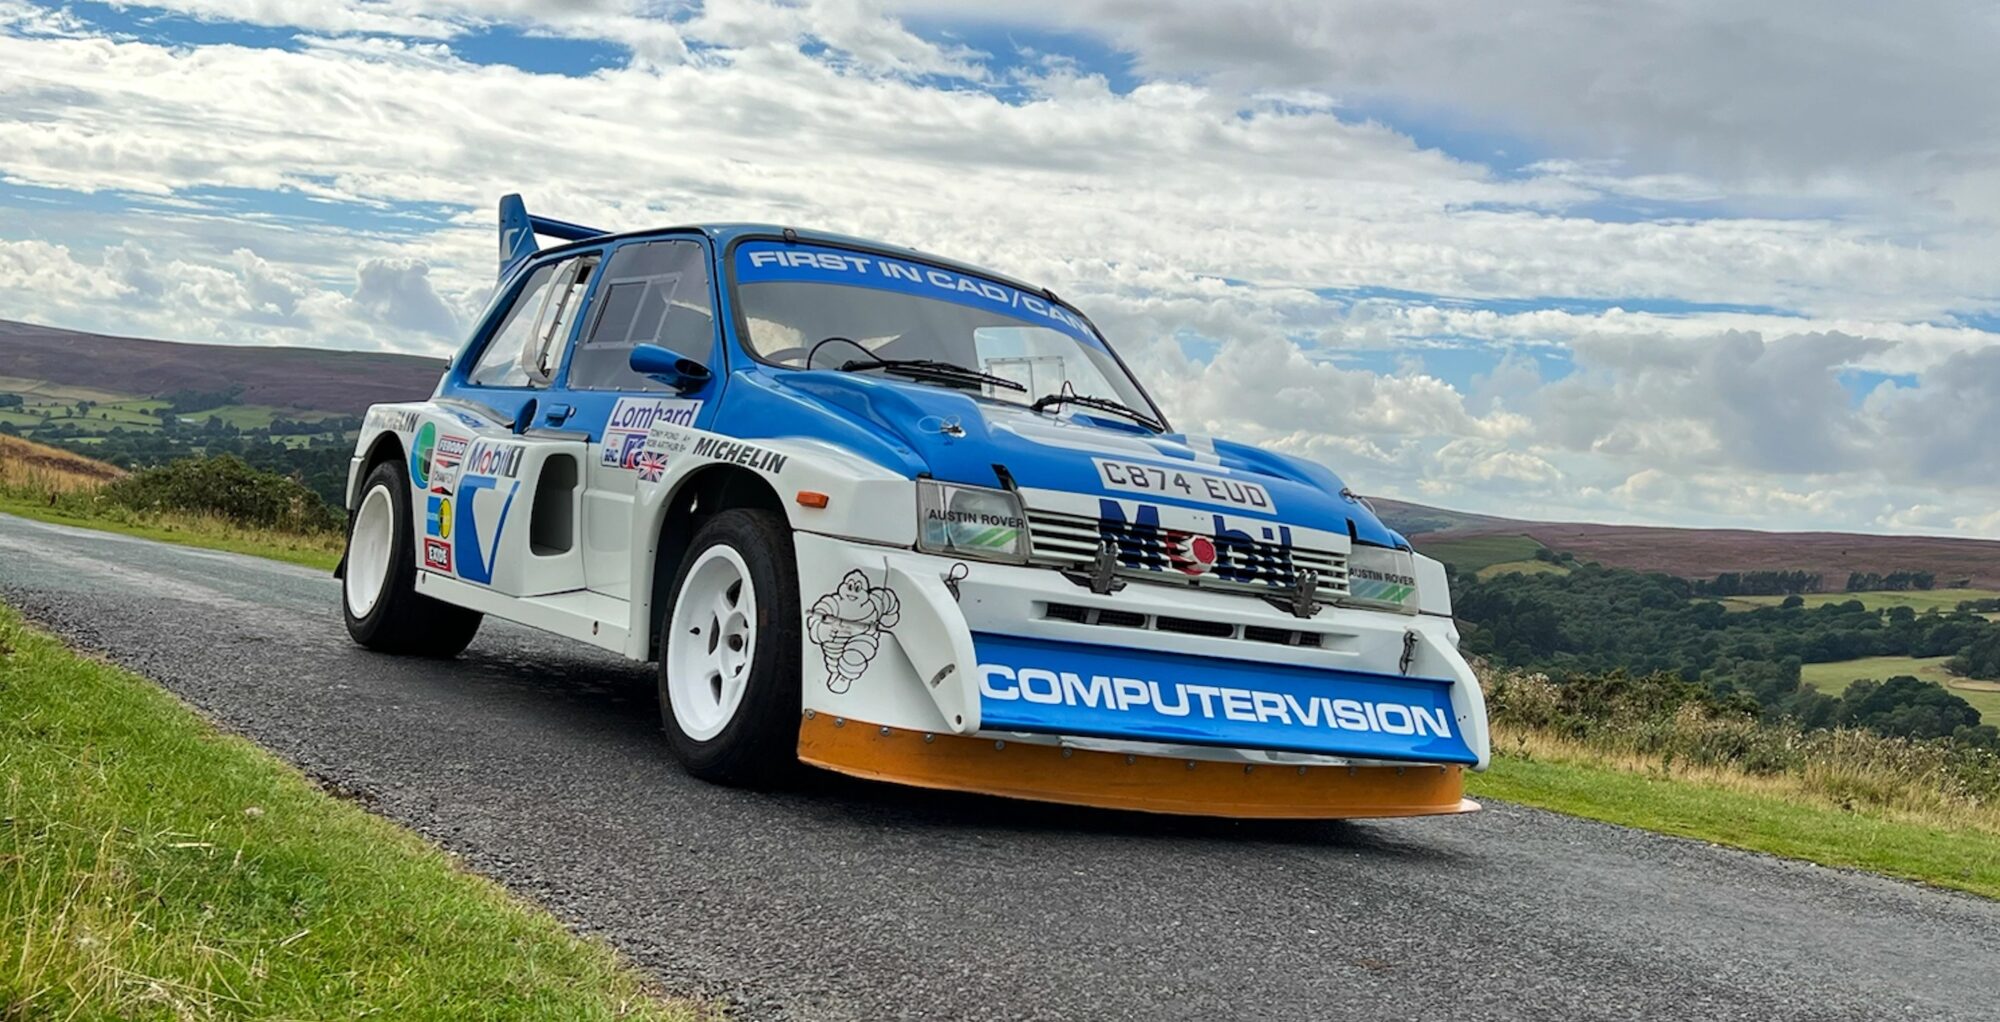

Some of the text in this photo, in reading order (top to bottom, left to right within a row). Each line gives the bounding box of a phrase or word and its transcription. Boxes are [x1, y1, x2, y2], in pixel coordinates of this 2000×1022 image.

[749, 251, 871, 273] FIRST
[878, 261, 923, 283] IN
[369, 407, 420, 432] CHELIN
[611, 400, 698, 429] Lombard
[438, 440, 467, 455] FERODO
[467, 442, 512, 476] Mobil
[692, 437, 788, 474] MICHELIN
[1102, 462, 1268, 508] C874 EUD
[928, 509, 1025, 529] AUSTIN ROVER
[428, 546, 448, 565] EXIDE
[1348, 567, 1415, 586] AUSTIN ROVER
[978, 663, 1452, 738] COMPUTERVISION
